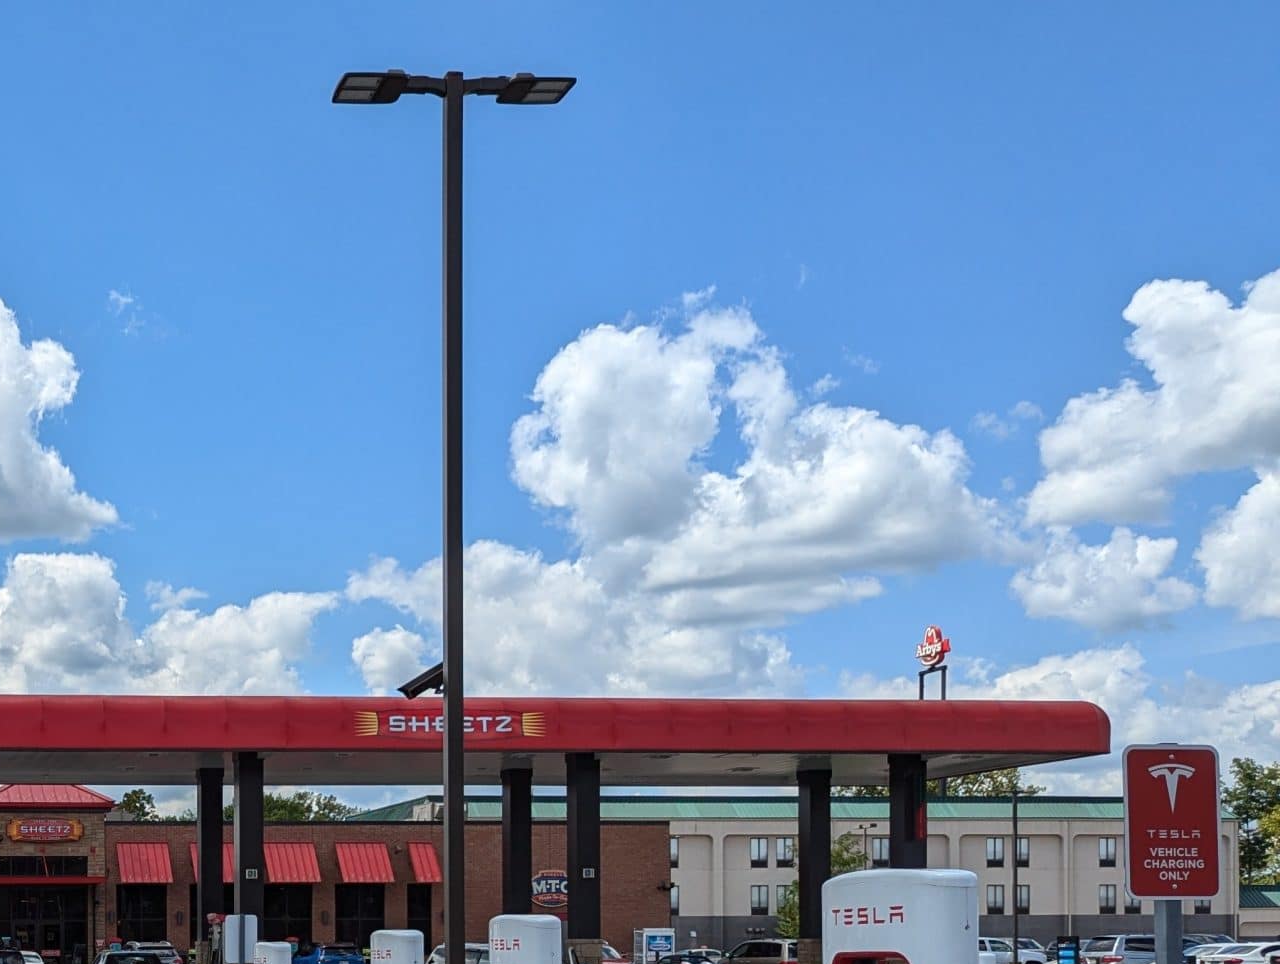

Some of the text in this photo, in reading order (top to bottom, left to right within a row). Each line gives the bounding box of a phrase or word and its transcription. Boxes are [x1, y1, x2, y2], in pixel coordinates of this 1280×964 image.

[20, 825, 71, 834] SHEETZ
[1146, 829, 1201, 839] TESLA
[1150, 847, 1199, 857] VEHICLE
[1144, 859, 1205, 869] CHARGING
[1159, 871, 1190, 881] ONLY
[831, 905, 904, 927] TESLA
